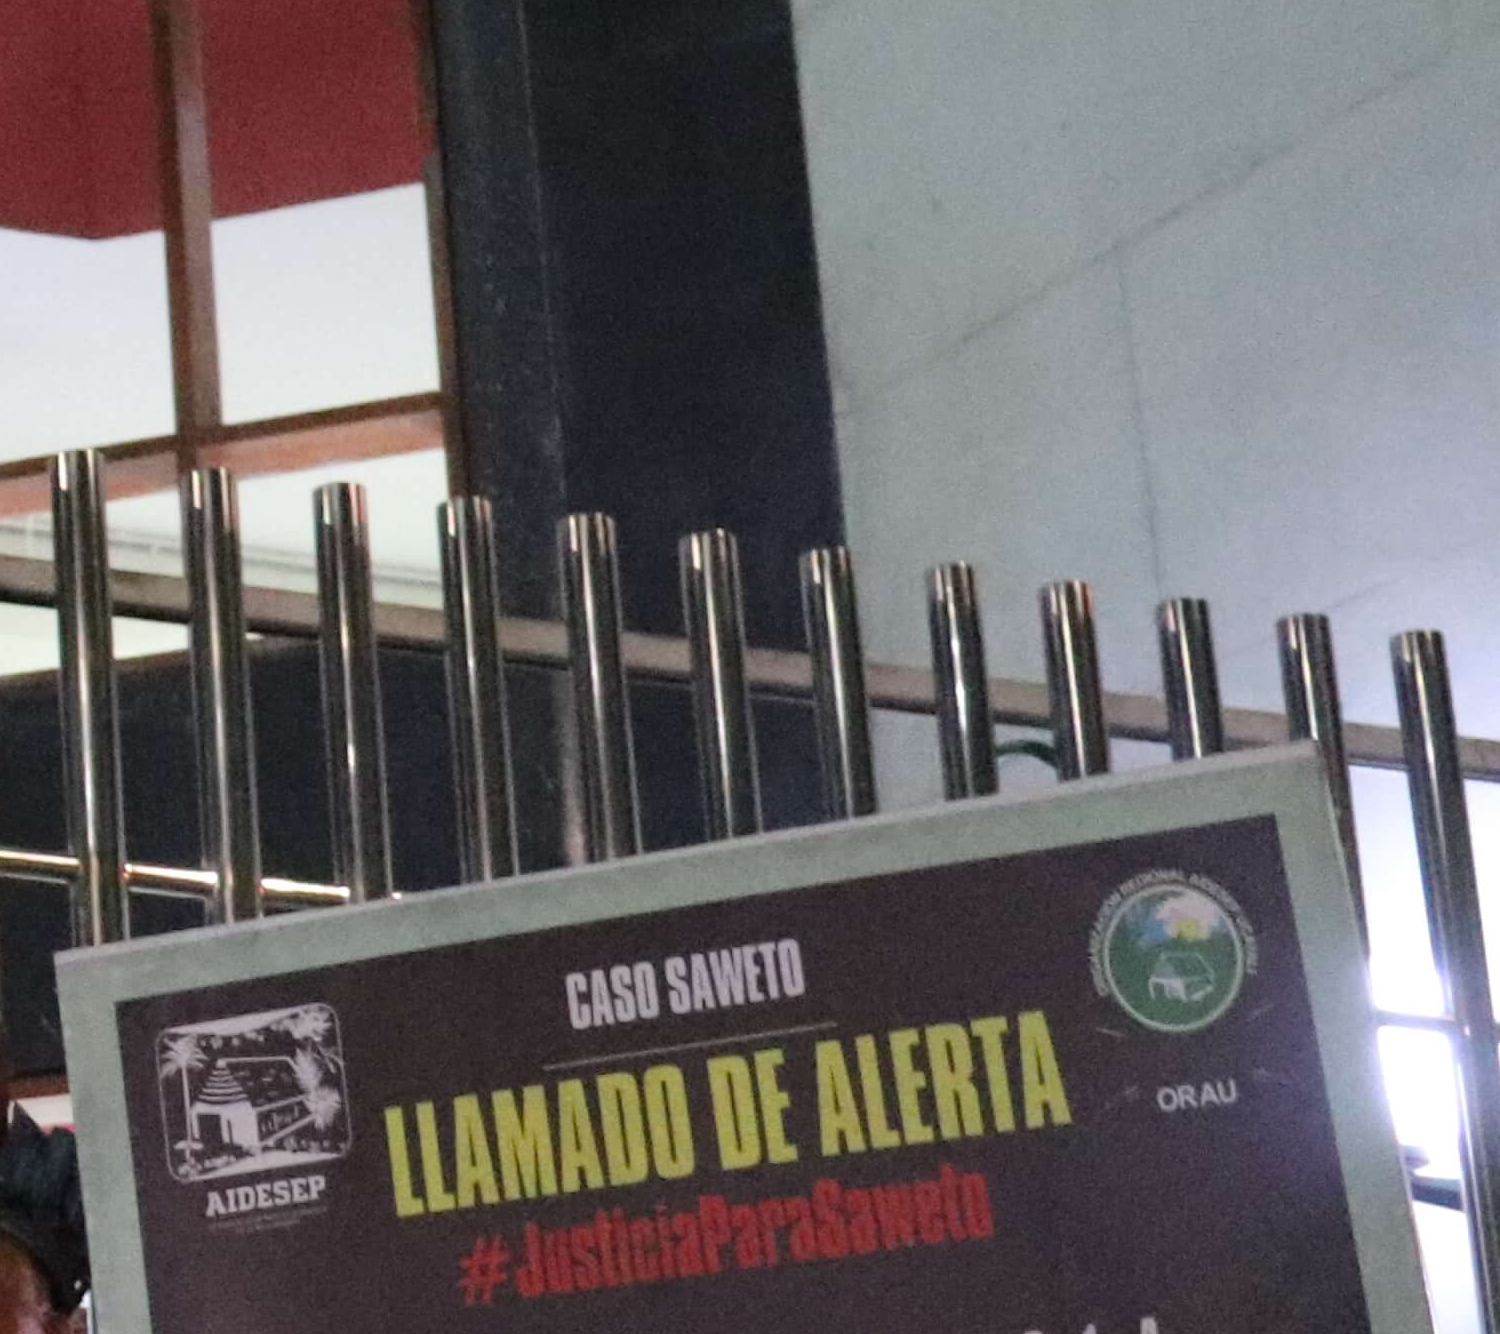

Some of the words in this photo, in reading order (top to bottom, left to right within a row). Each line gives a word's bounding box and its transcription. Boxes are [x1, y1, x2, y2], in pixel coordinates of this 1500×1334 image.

[566, 959, 660, 1030] CASO
[664, 938, 806, 1015] SAWETO
[384, 1063, 695, 1219] LLAMADO
[706, 1048, 799, 1172] DE
[815, 1010, 1073, 1158] ALERTA
[1156, 1078, 1238, 1113] ORAU
[205, 1174, 327, 1218] AIDESEP
[457, 1164, 995, 1306] #JusticiaParaSaweto
